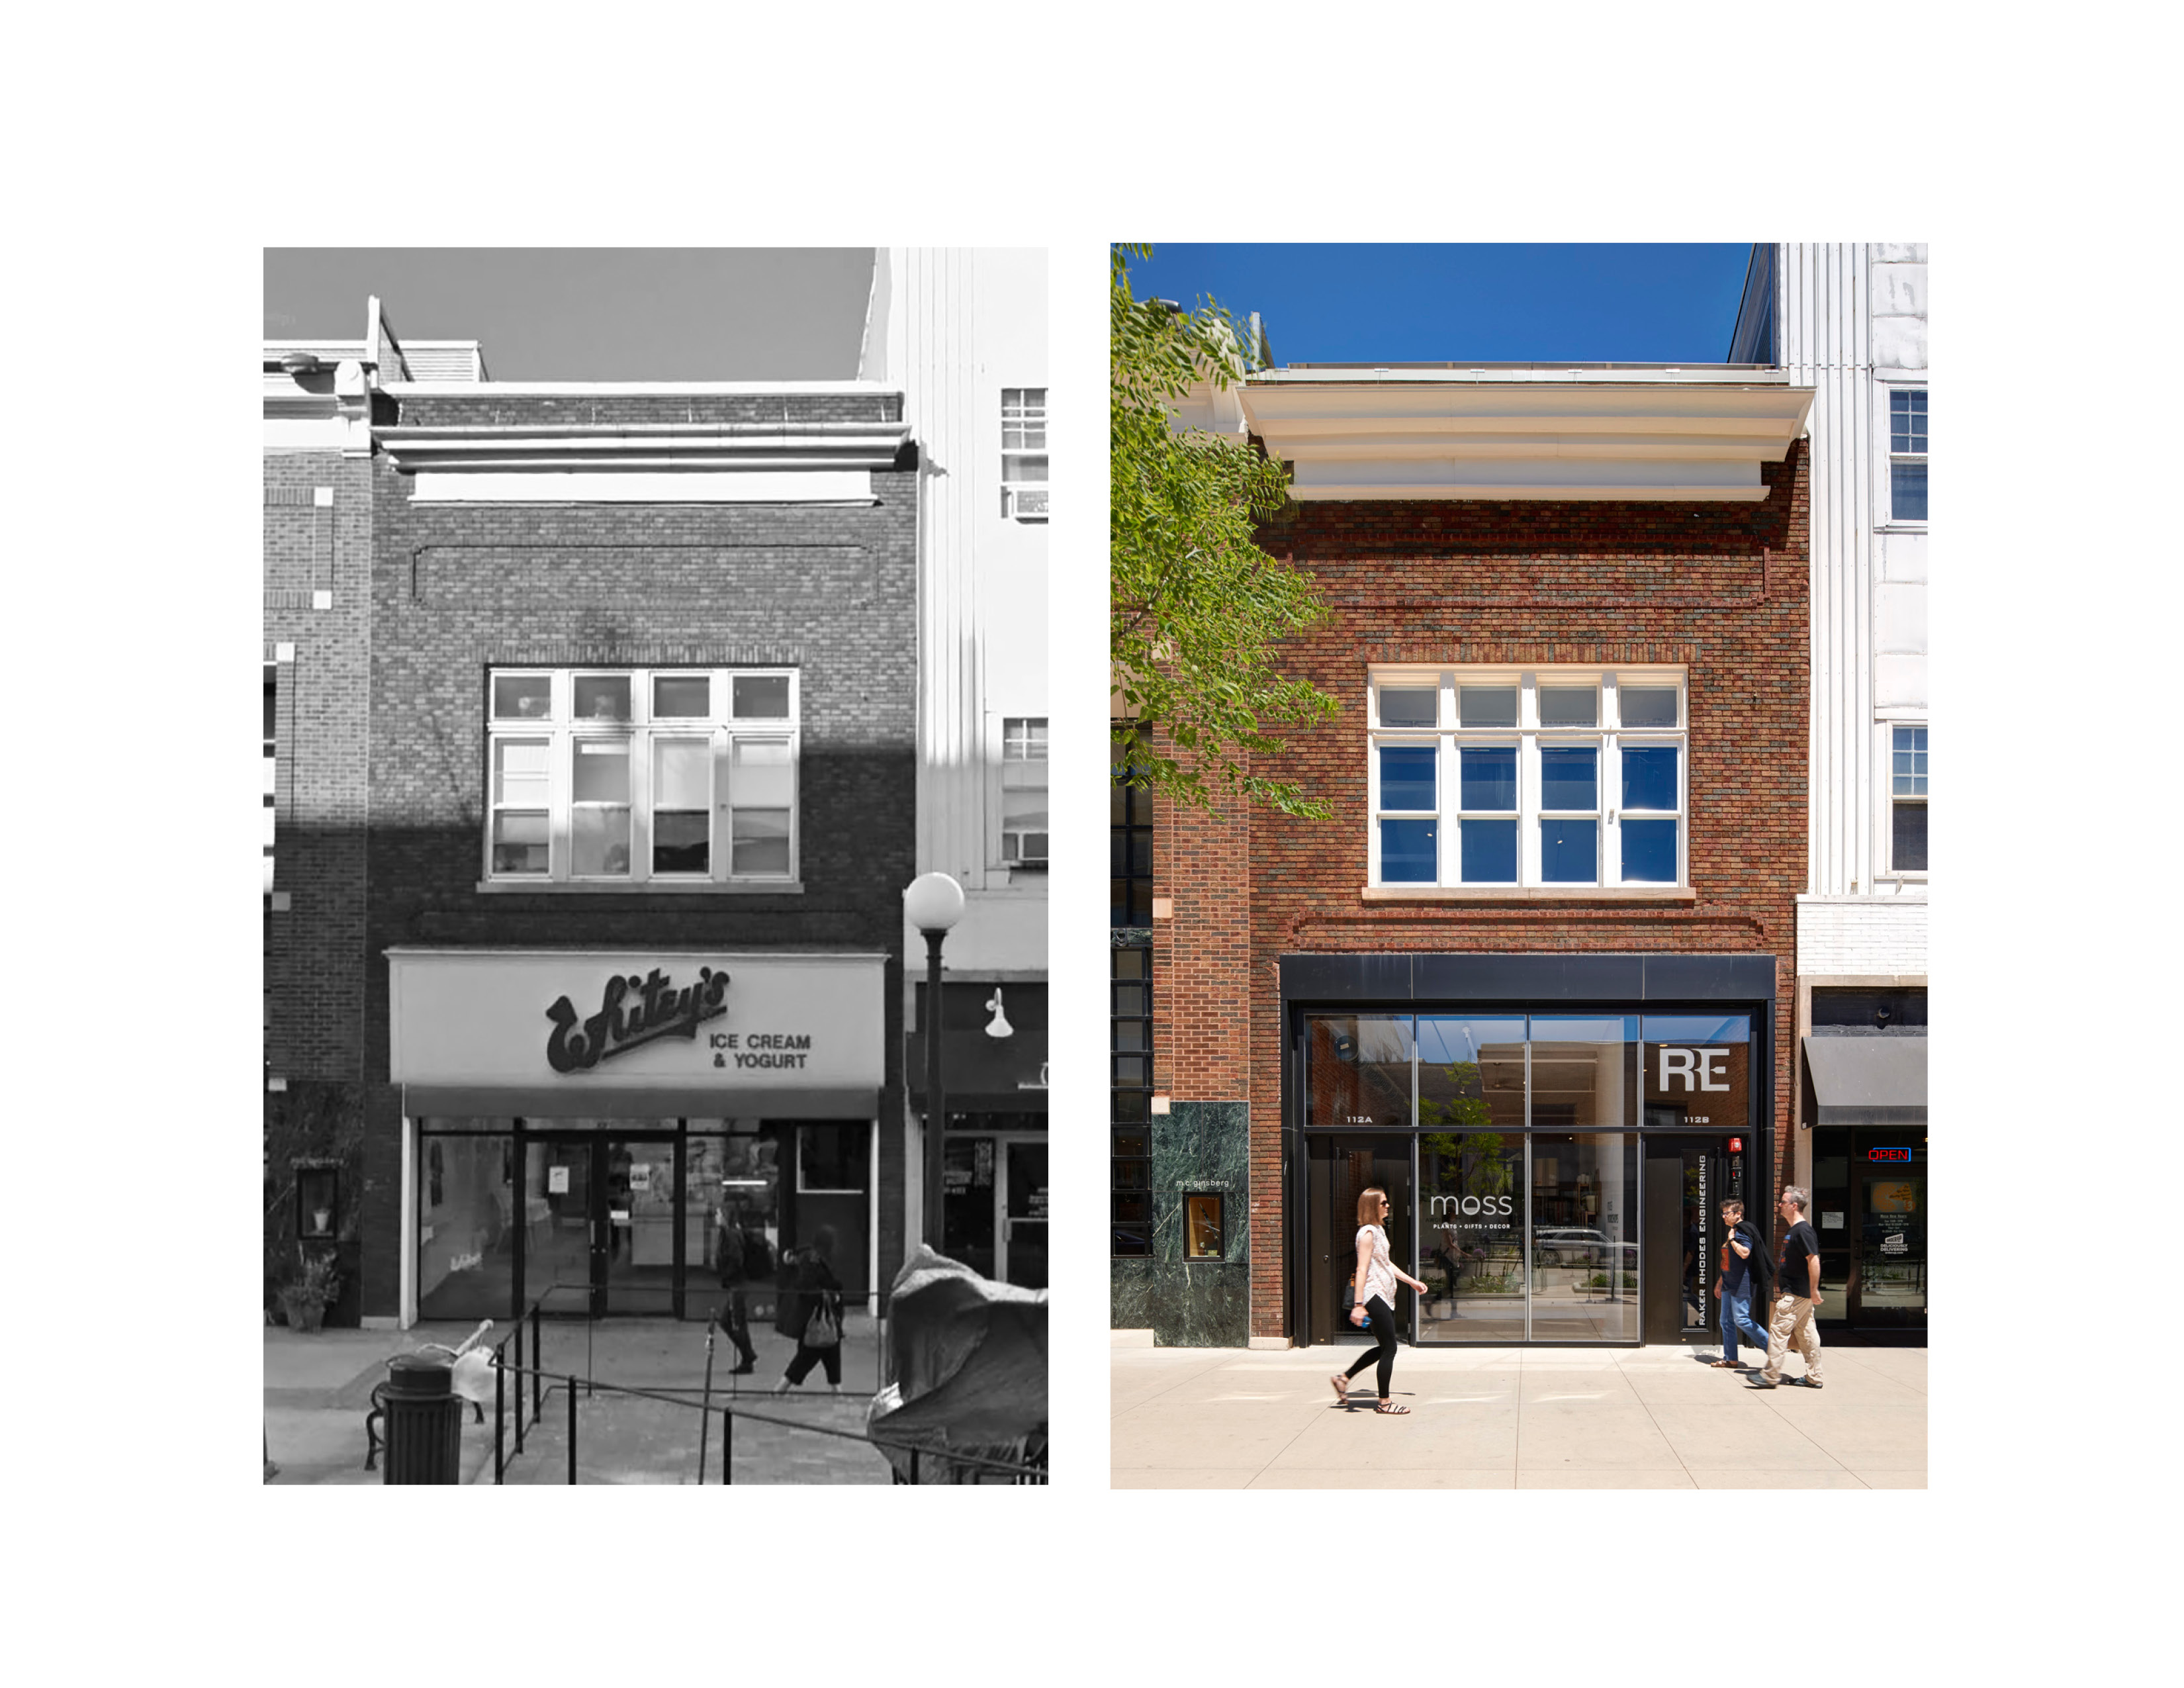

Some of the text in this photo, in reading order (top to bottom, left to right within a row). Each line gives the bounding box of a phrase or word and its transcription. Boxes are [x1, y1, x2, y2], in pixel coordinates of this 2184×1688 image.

[546, 966, 730, 1073] Whitey's
[709, 1033, 811, 1049] ICE CREAM
[713, 1053, 807, 1068] & YOGURT
[1659, 1049, 1729, 1092] RE
[1868, 1150, 1907, 1160] OPEN
[1430, 1196, 1512, 1215] moss
